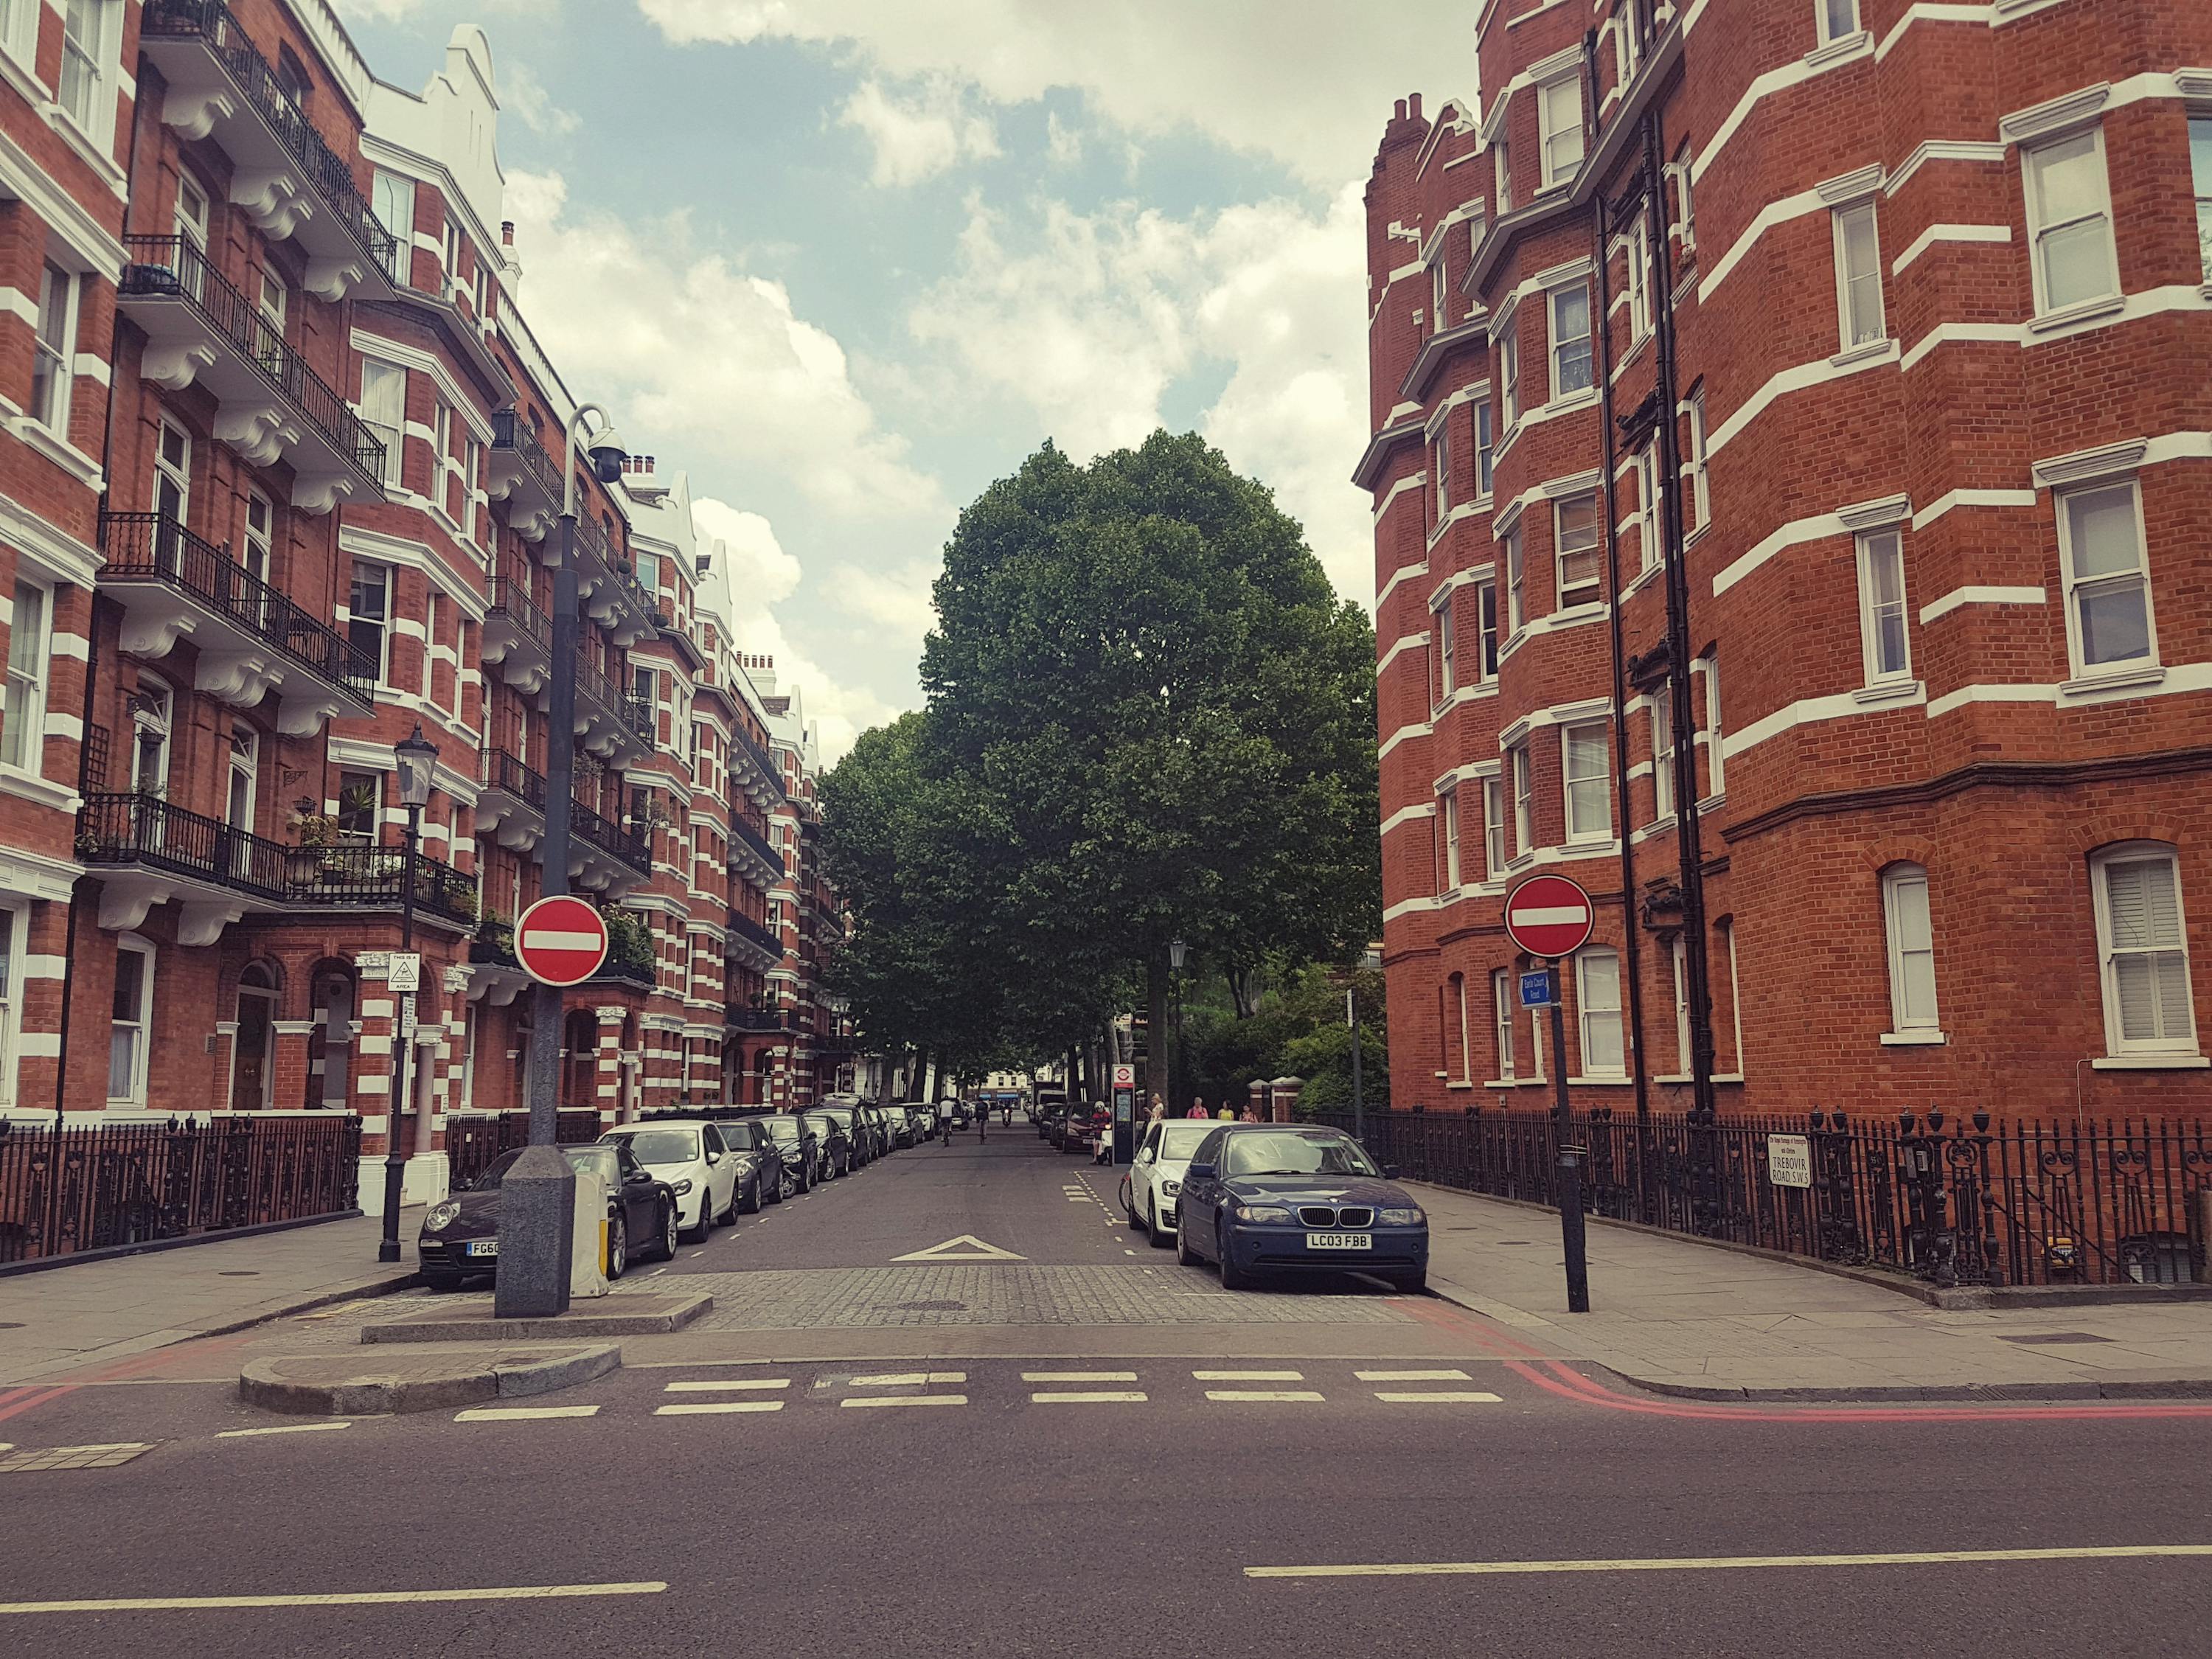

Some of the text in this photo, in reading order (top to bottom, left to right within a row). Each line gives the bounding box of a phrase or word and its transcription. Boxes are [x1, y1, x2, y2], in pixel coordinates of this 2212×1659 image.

[1773, 1156, 1806, 1170] TREBOVIR
[1312, 1235, 1367, 1247] LC03 FBB
